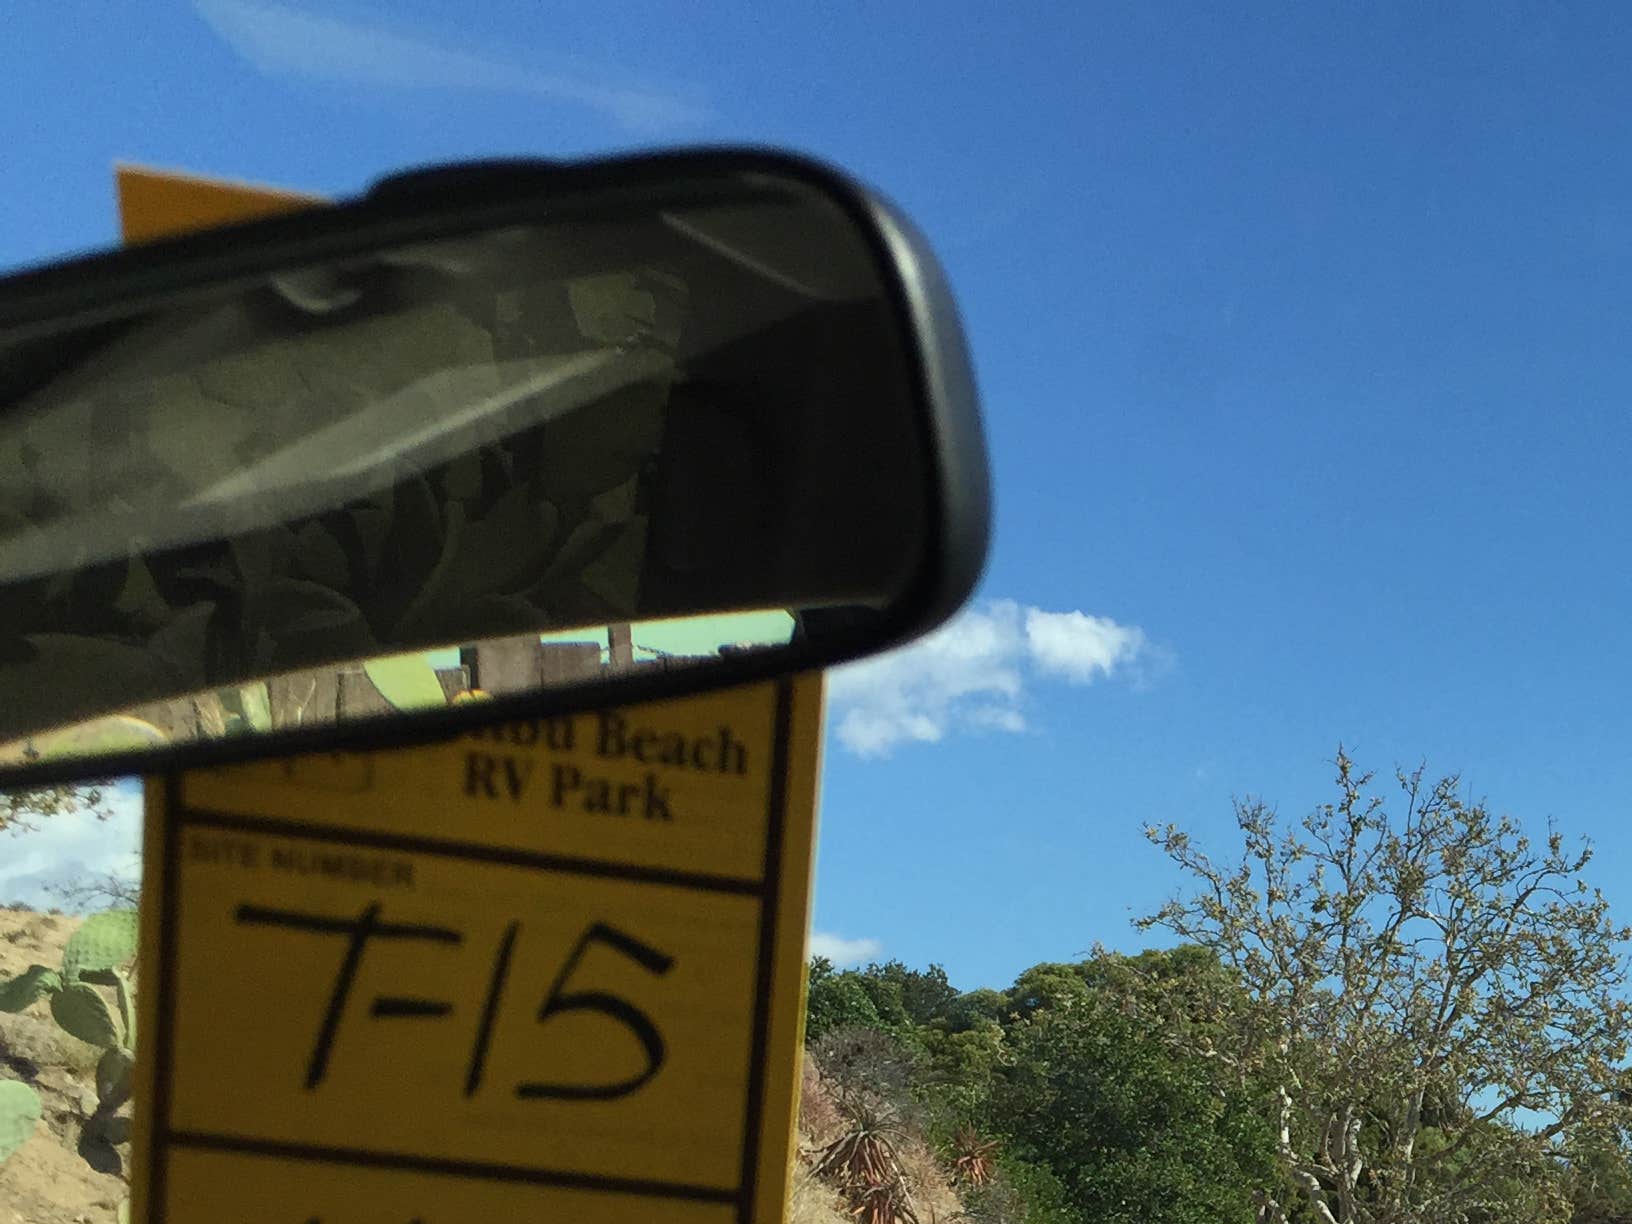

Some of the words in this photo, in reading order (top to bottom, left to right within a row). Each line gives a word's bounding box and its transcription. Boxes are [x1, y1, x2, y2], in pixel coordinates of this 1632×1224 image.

[593, 708, 748, 776] Beach
[463, 750, 530, 800] RV
[551, 763, 675, 824] Park
